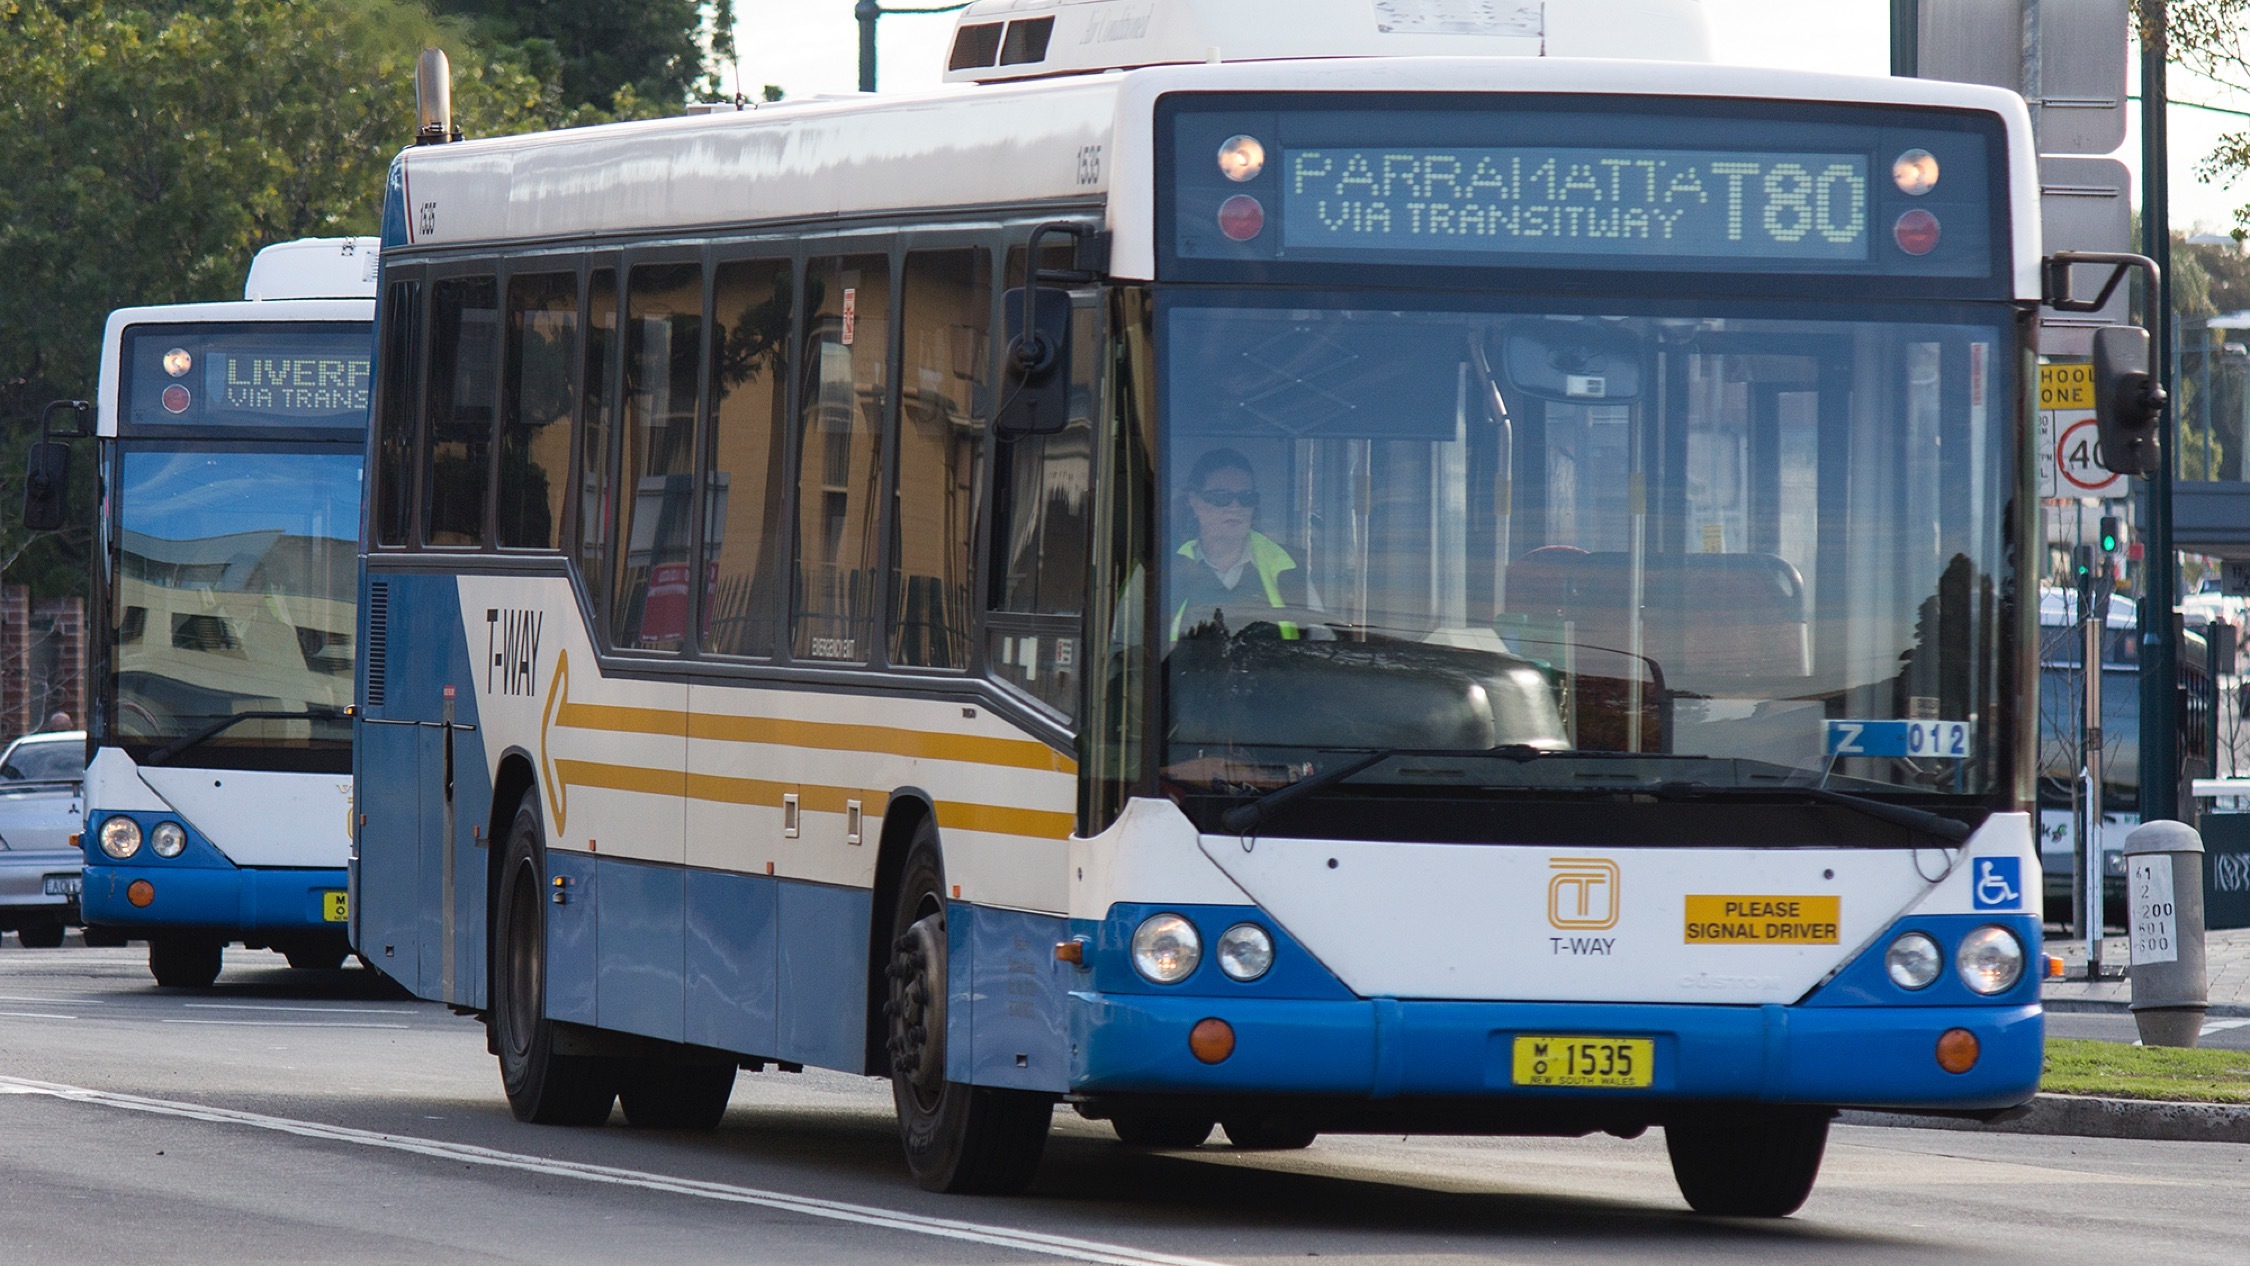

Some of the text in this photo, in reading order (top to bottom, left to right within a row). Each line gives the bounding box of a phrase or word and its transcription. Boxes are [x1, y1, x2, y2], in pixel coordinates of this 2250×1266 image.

[1077, 145, 1101, 185] 1535
[1296, 152, 1708, 204] PARRAMATTA
[1711, 162, 1865, 243] T80
[419, 202, 436, 236] 1535
[1318, 201, 1684, 239] VIA TRANSITWAY
[228, 359, 370, 387] LIVERP
[228, 388, 368, 409] VIA TRANS
[487, 608, 543, 697] T-WAY
[1837, 723, 1965, 754] Z 012
[1725, 902, 1800, 917] PLEASE
[1687, 922, 1837, 940] SIGNAL DRIVER
[1550, 938, 1616, 956] T-WAY
[1566, 1044, 1634, 1076] 1535
[1530, 1076, 1637, 1086] NEW SOUTH WALES
